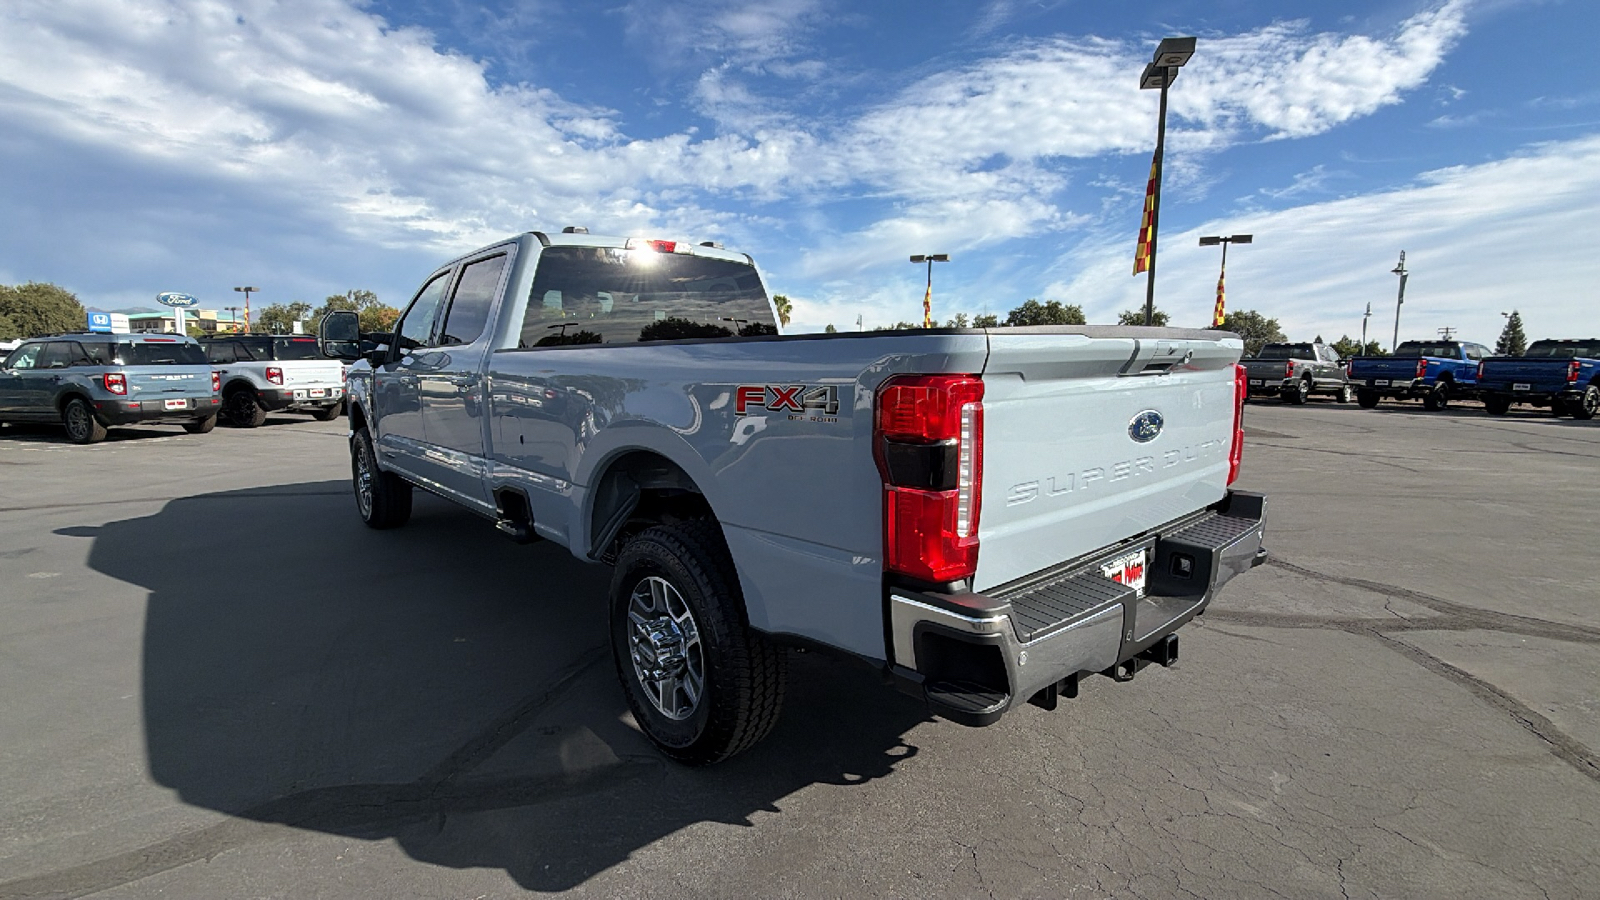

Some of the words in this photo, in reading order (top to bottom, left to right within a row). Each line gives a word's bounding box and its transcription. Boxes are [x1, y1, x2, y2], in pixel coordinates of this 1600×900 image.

[167, 294, 192, 305] Ford
[735, 384, 839, 416] FX4
[1006, 455, 1155, 508] SUPER
[1162, 436, 1228, 470] DUTY
